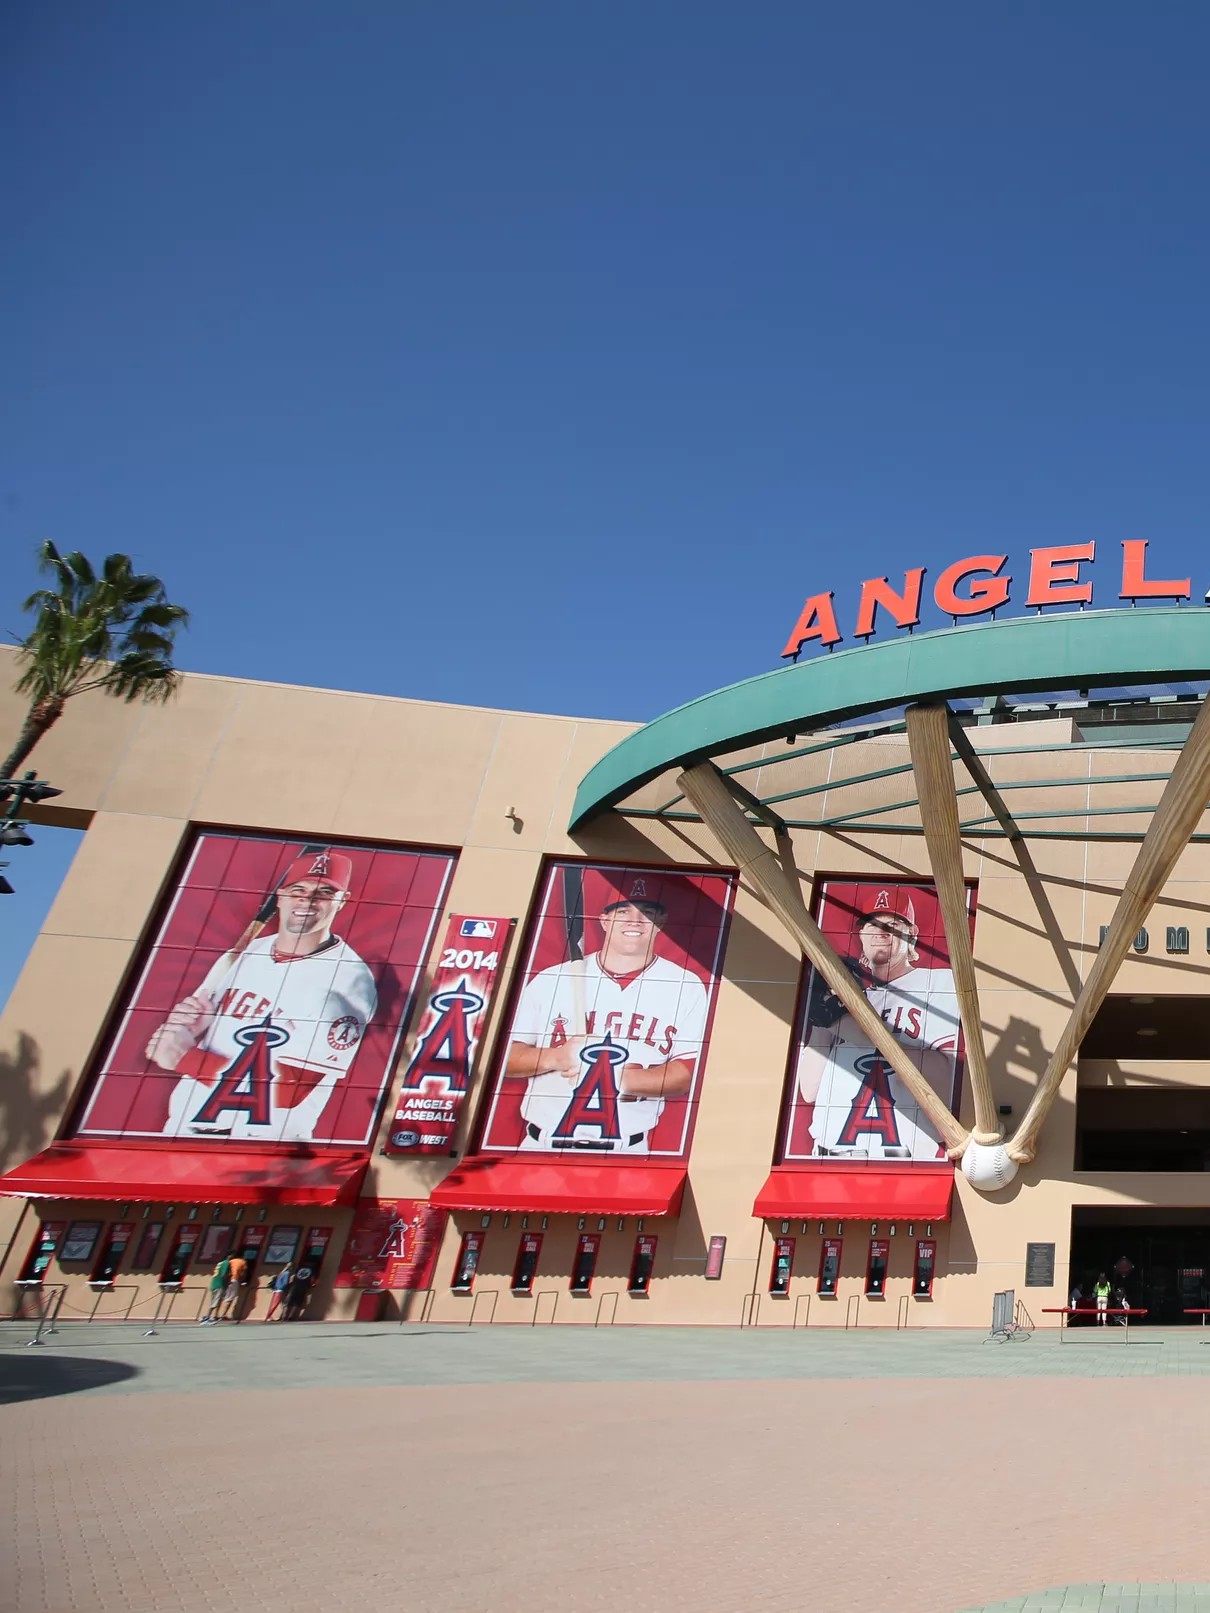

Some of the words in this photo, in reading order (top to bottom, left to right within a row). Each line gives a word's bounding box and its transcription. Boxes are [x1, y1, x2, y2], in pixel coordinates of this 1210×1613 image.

[780, 539, 1191, 659] ANGEL
[438, 949, 499, 971] 2014
[404, 976, 484, 1092] A
[190, 1012, 290, 1125] A
[551, 1030, 630, 1139] A
[404, 1098, 453, 1110] ANGELS
[836, 1048, 902, 1147] A
[395, 1109, 456, 1122] BASEBALL
[419, 1133, 448, 1145] WEST
[480, 1213, 549, 1230] WILL
[577, 1216, 645, 1232] CALL
[781, 1221, 843, 1236] WILL
[870, 1223, 933, 1238] CALL
[919, 1249, 933, 1258] VIP
